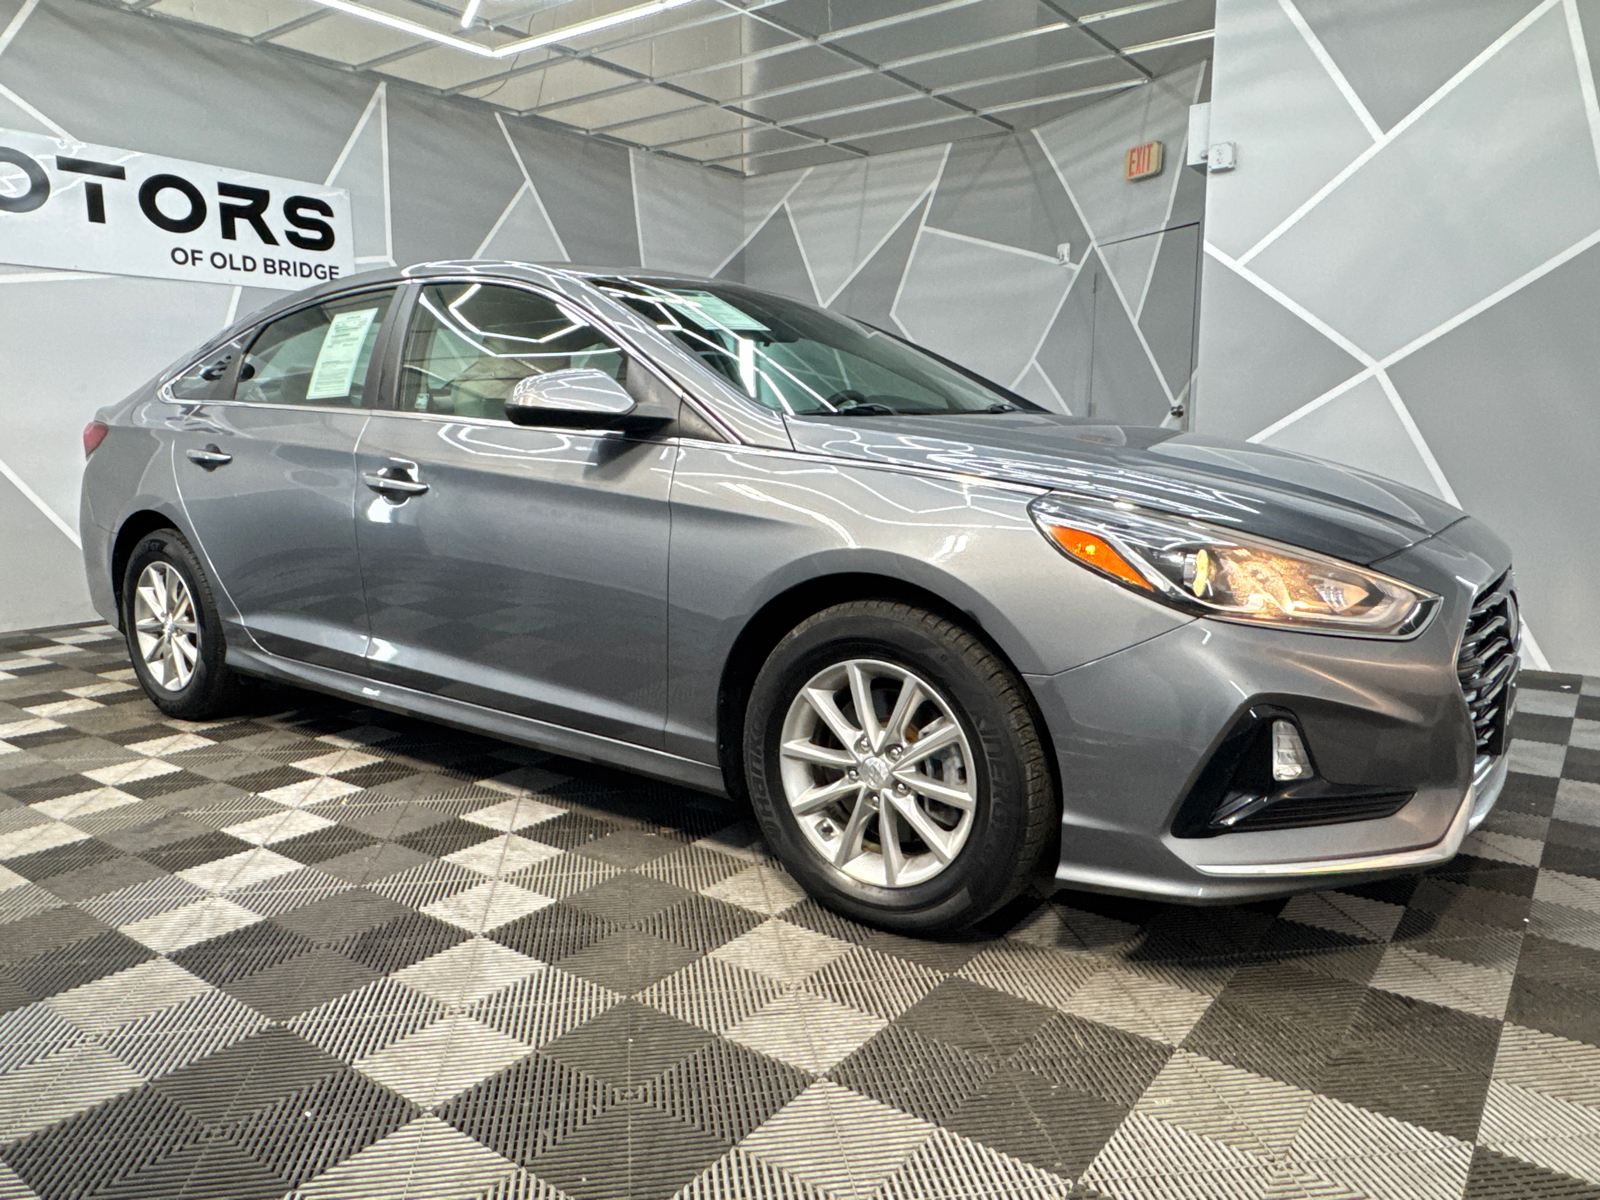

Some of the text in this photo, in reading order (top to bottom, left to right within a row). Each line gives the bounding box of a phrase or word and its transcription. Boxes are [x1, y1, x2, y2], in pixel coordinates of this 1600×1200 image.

[1128, 143, 1153, 177] EXIT
[170, 247, 339, 280] OF OLD BRIDGE
